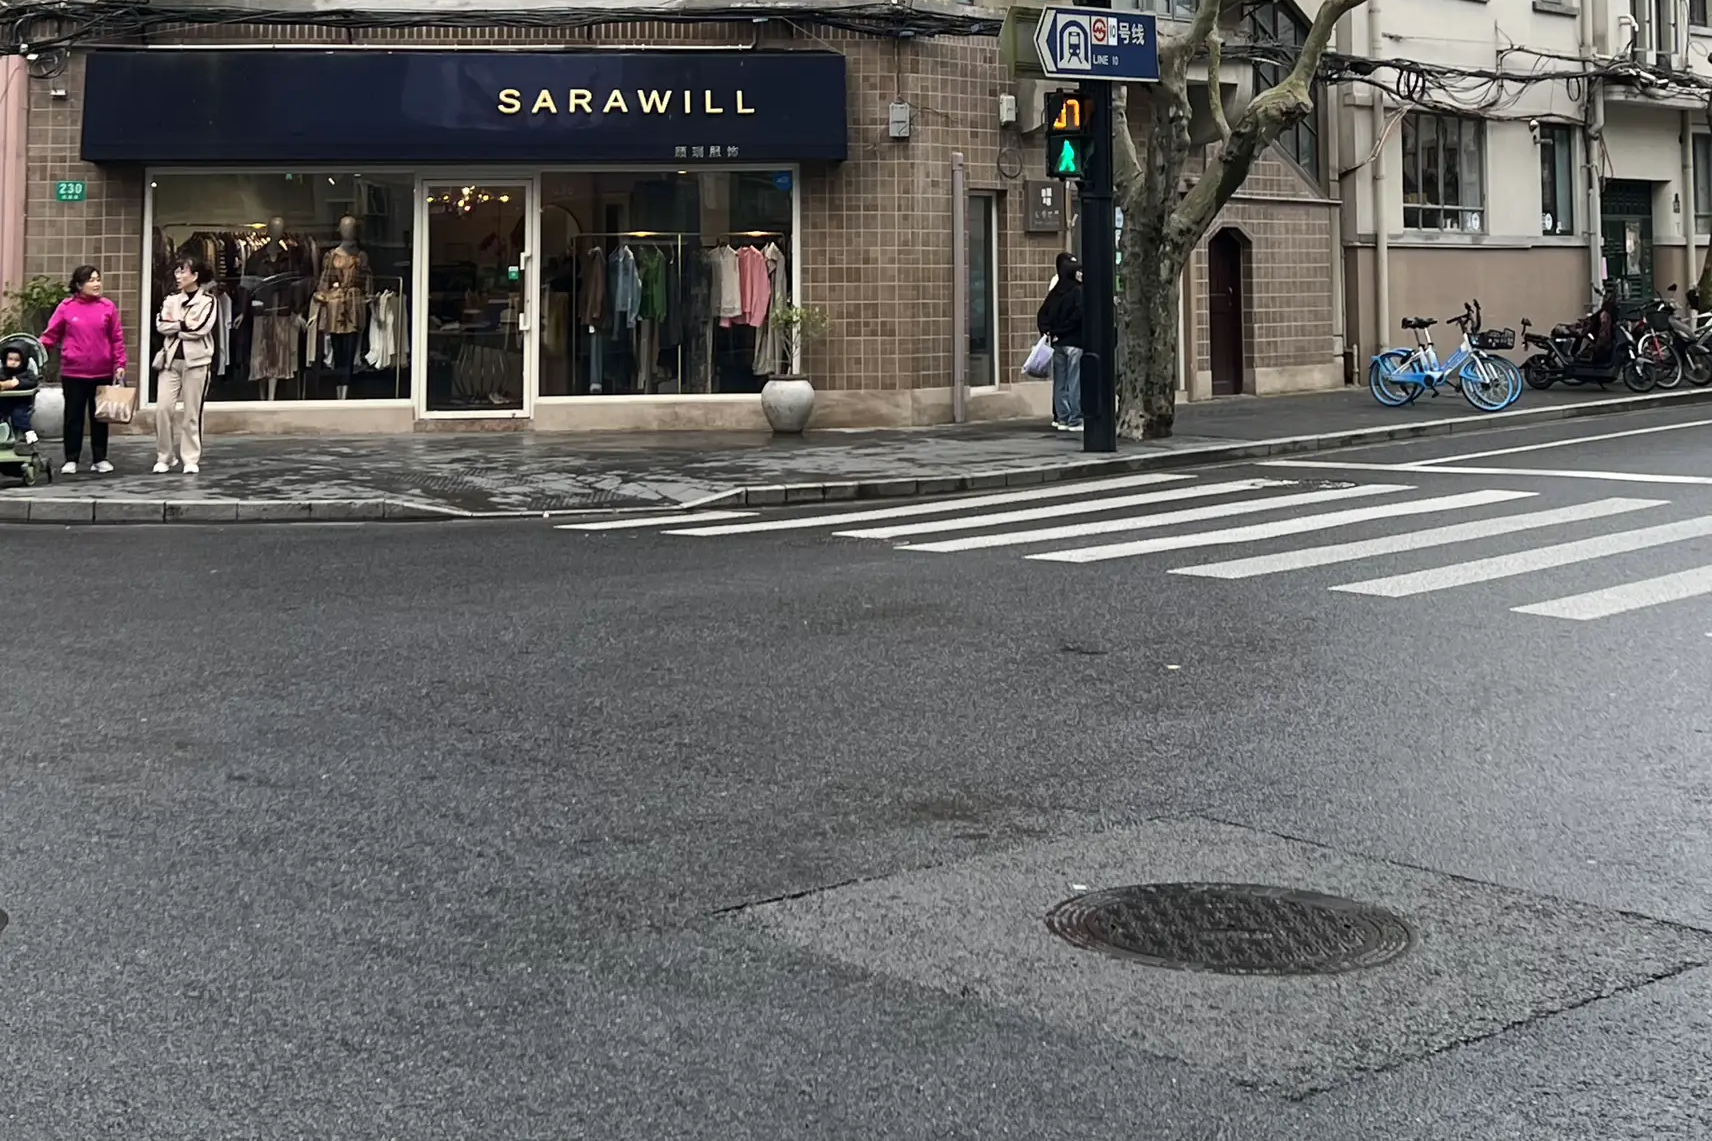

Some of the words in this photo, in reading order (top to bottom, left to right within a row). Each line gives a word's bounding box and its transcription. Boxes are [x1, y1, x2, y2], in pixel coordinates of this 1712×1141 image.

[1092, 54, 1109, 66] LINE
[1112, 55, 1119, 66] 10
[497, 89, 756, 114] SARAWILL
[58, 183, 83, 195] 230
